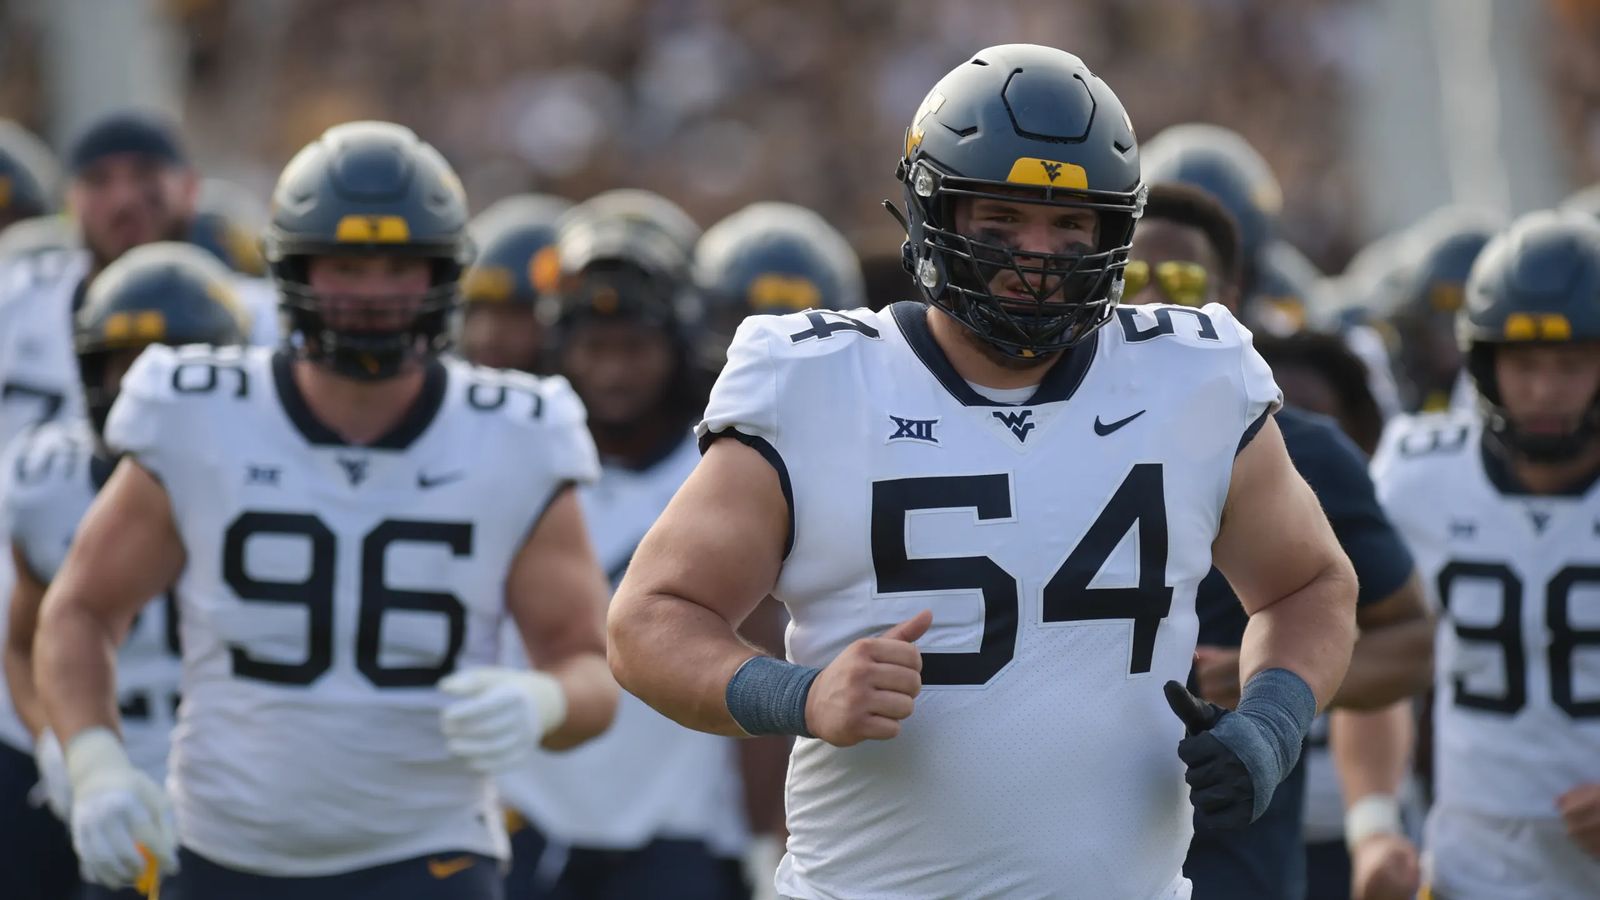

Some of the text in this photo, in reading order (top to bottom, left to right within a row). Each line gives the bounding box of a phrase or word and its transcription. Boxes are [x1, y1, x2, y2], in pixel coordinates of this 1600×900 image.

[889, 415, 938, 443] XII
[222, 510, 474, 687] 96
[870, 463, 1174, 685] 54
